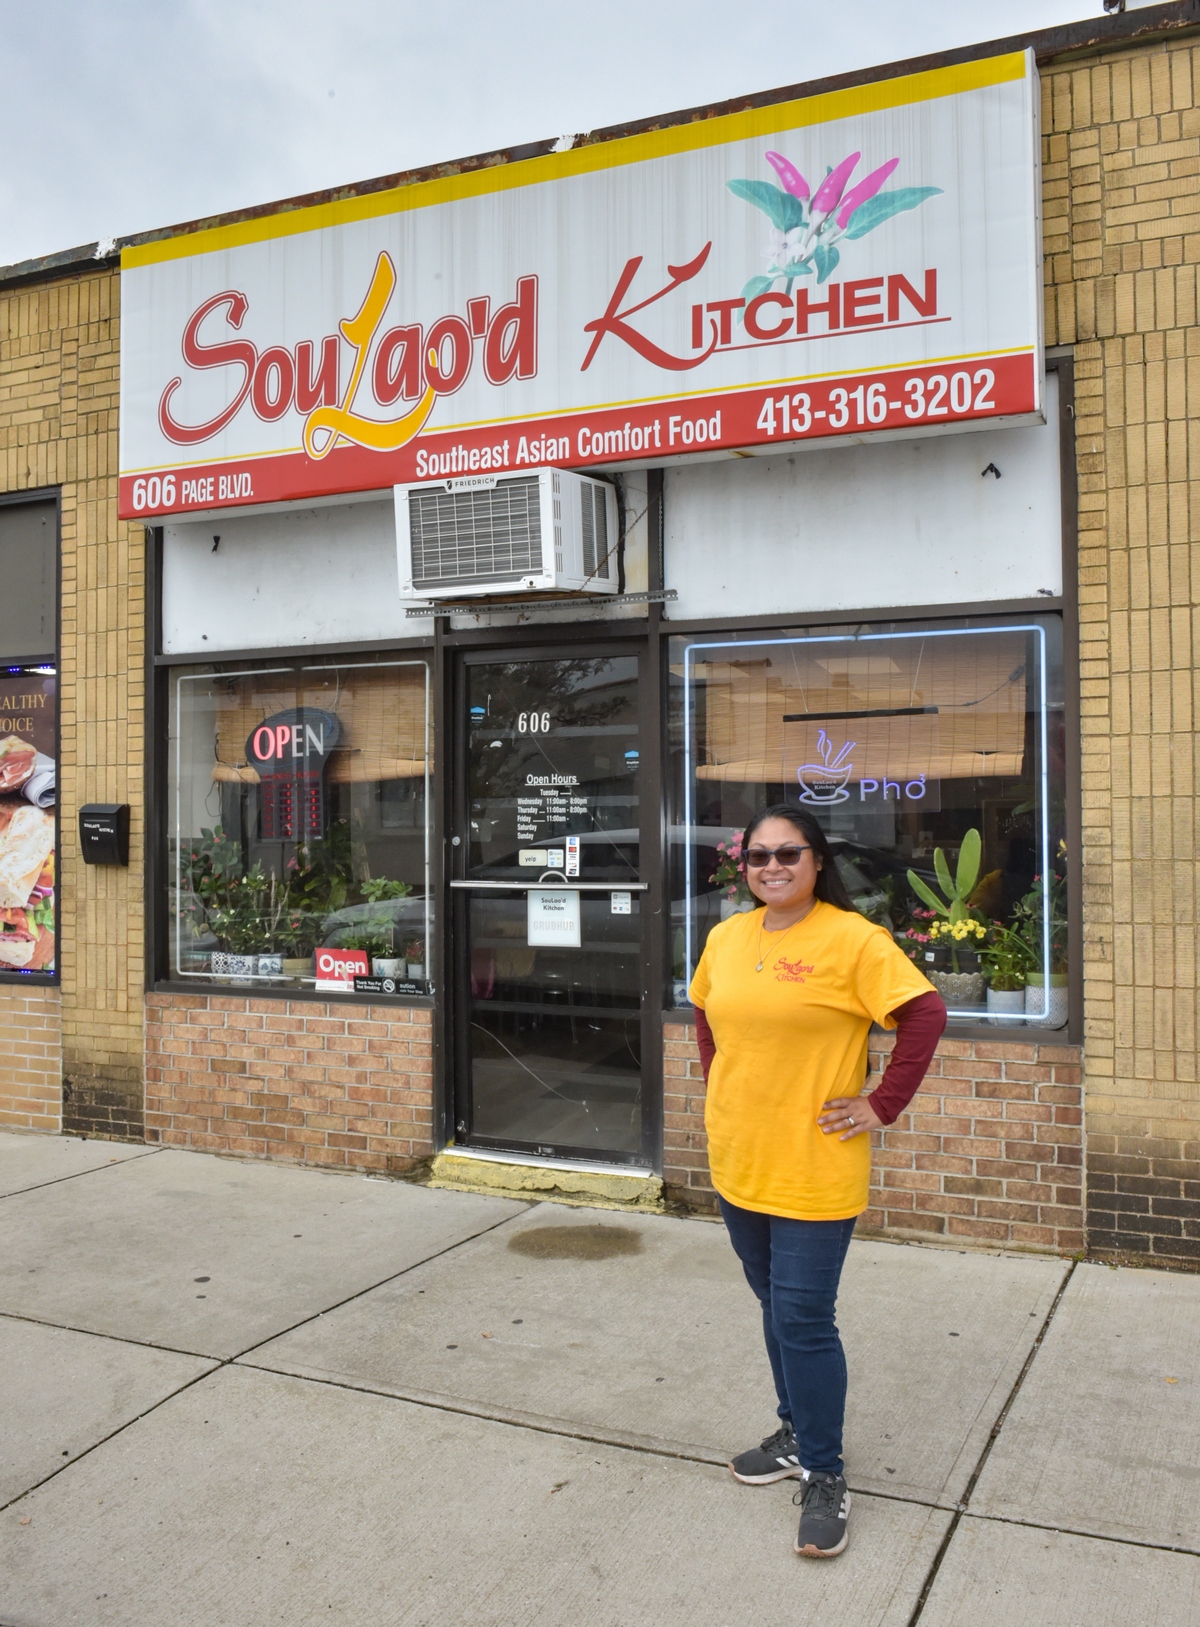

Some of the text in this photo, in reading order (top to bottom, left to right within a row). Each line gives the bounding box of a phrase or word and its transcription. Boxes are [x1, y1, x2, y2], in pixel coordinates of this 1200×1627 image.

[757, 368, 996, 436] 413-316-3202
[415, 409, 723, 478] Southeast Asian Comfort Food
[454, 477, 495, 487] FRIEDRICH
[132, 472, 254, 510] 606 PAGE BLVD.
[0, 693, 48, 710] ALTHY
[517, 712, 550, 733] 606
[253, 723, 324, 760] OPEN
[526, 774, 577, 785] Open Hours
[540, 789, 559, 797] Tuesday
[570, 798, 587, 806] 8:00pm
[517, 815, 531, 823] Friday
[517, 824, 537, 832] Saturday
[517, 832, 534, 840] Sunday
[533, 921, 575, 931] GRUBHUB
[319, 954, 366, 977] Open
